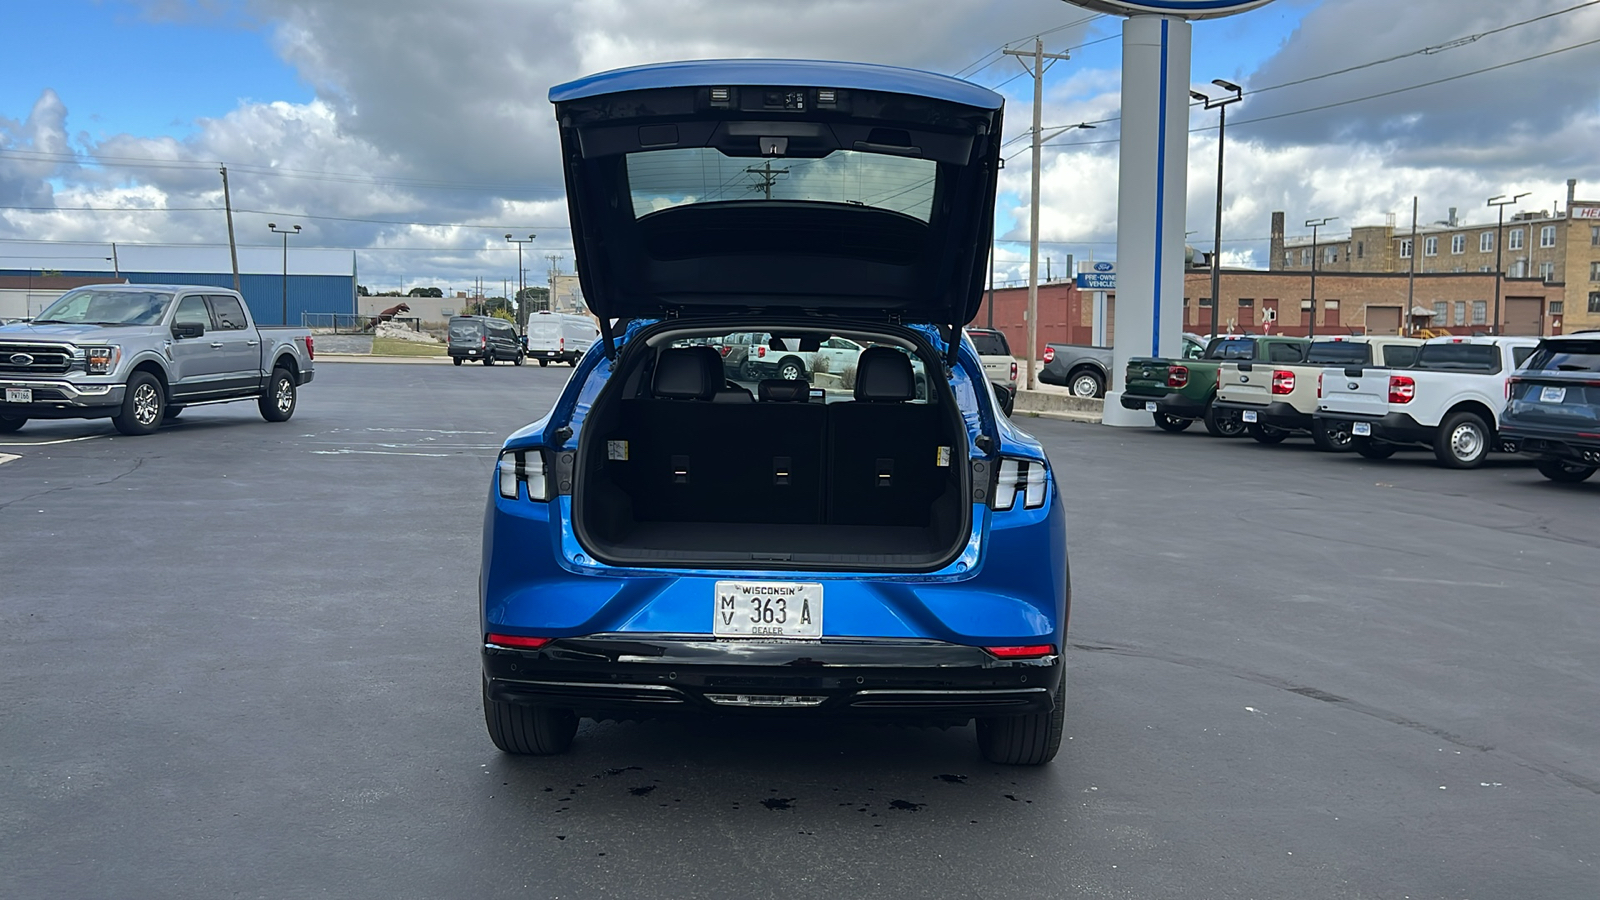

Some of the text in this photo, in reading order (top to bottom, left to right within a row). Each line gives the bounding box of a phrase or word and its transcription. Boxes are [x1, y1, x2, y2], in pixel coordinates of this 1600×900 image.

[1581, 208, 1600, 217] HE
[742, 586, 795, 595] WISCONSIN
[750, 597, 787, 624] 363
[800, 598, 811, 624] A
[752, 626, 783, 634] DEALER
